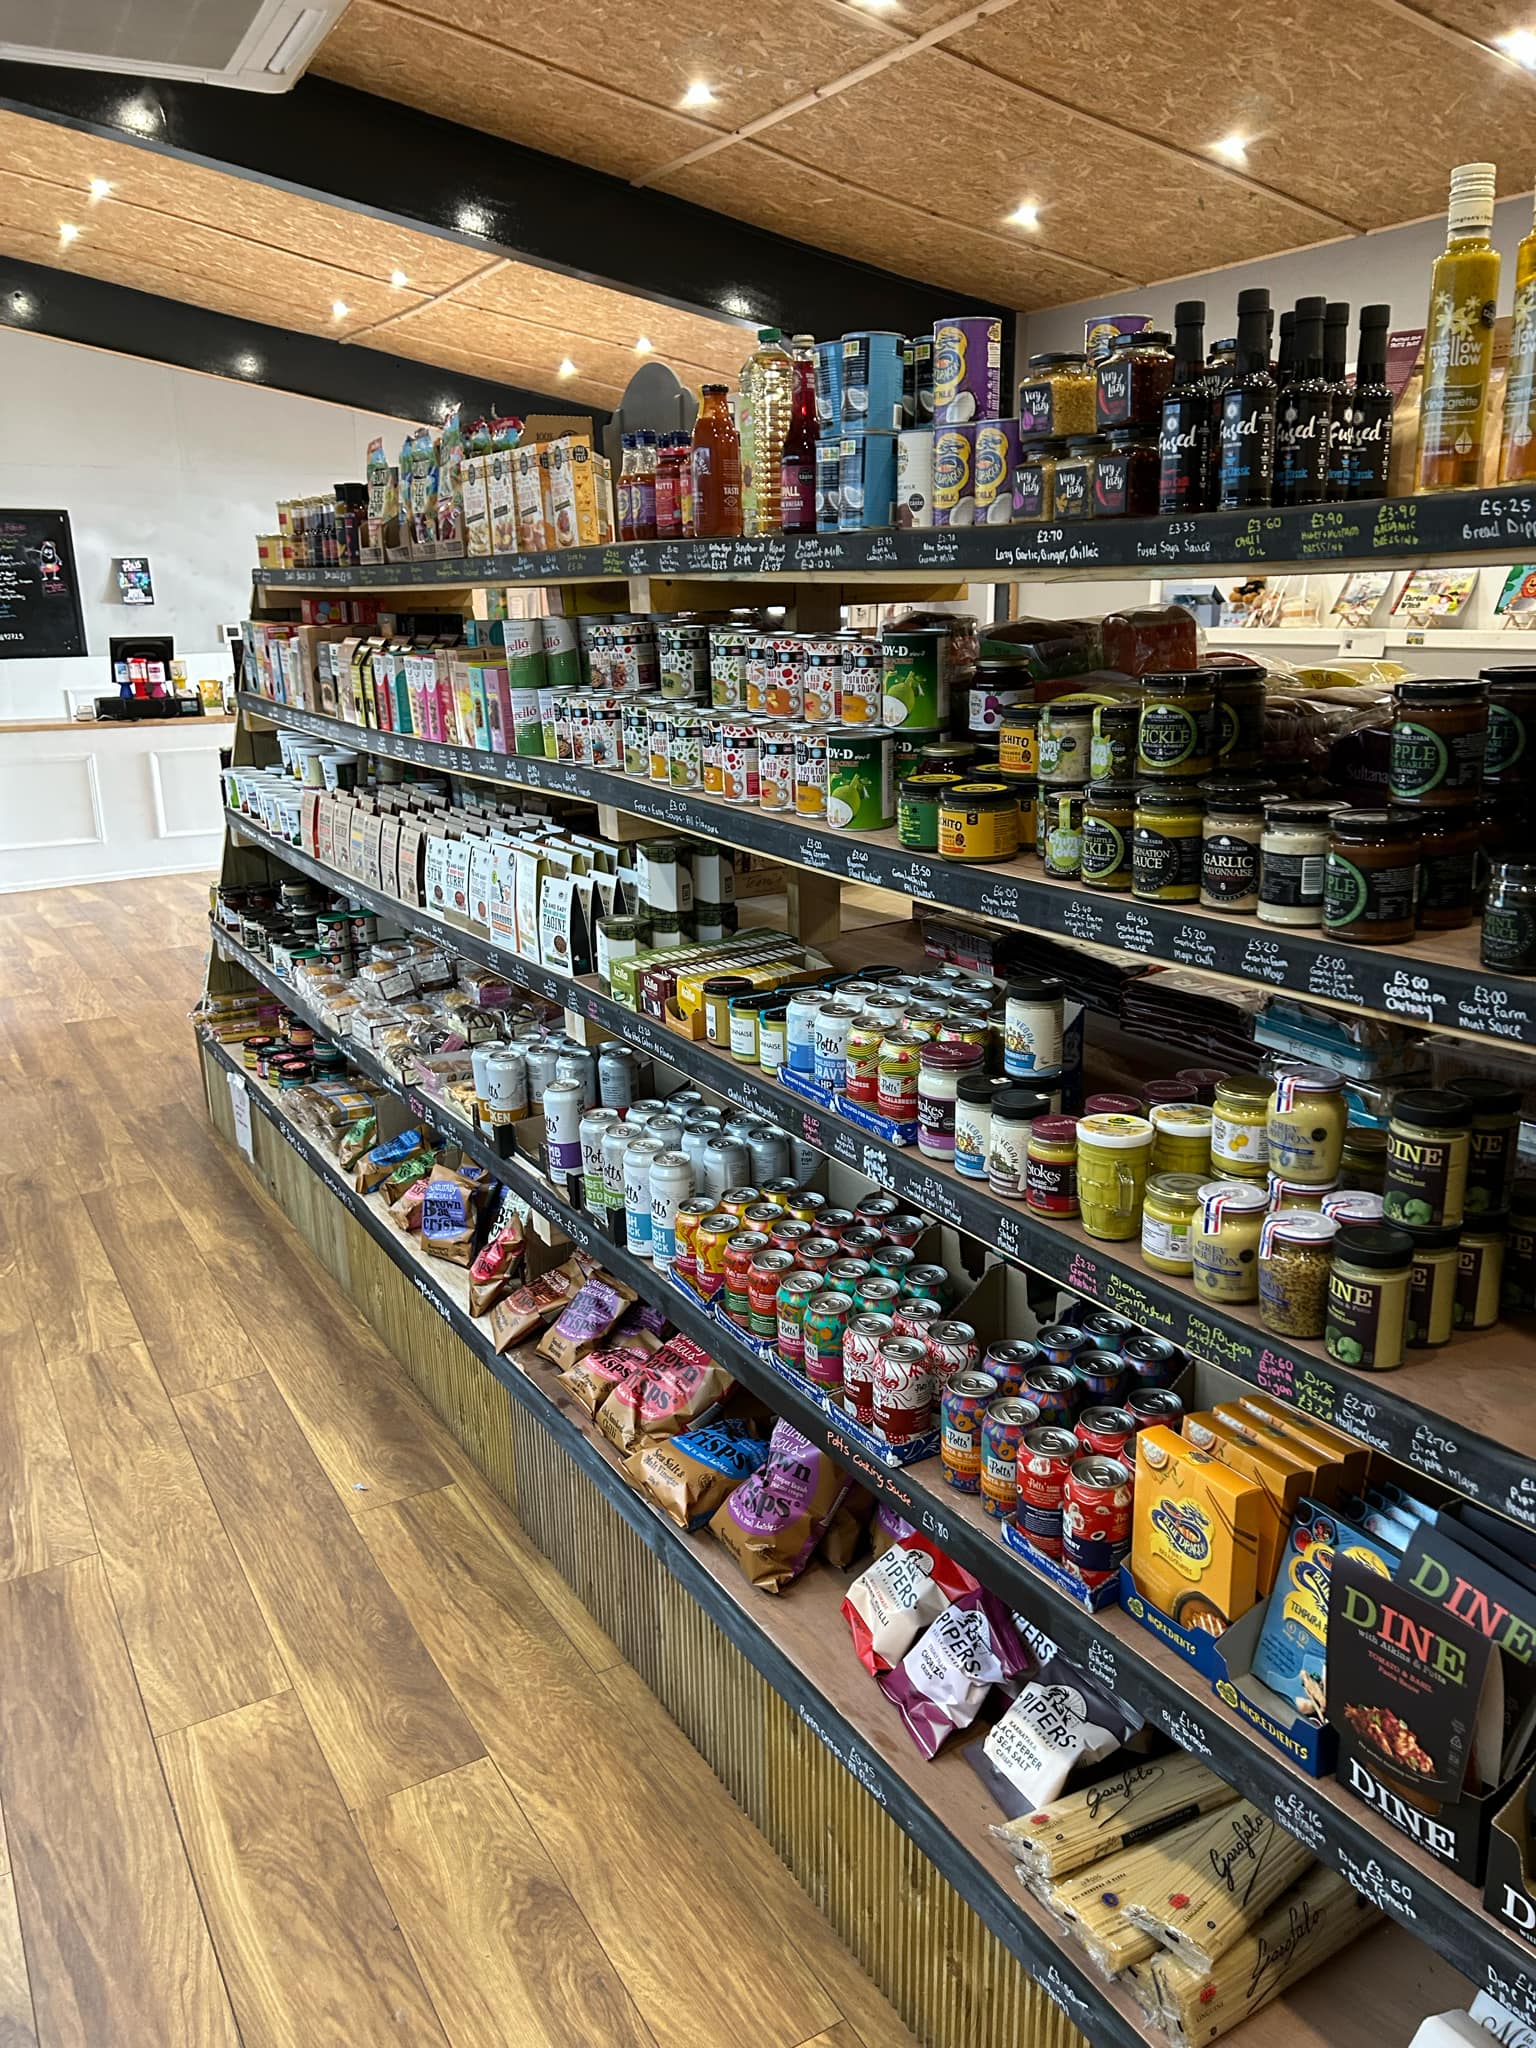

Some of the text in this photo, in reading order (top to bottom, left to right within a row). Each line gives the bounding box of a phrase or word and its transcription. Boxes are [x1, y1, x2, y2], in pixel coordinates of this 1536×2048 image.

[1429, 335, 1483, 355] mellow
[1432, 351, 1480, 372] yellow
[1100, 369, 1124, 386] Very
[1024, 389, 1048, 404] Very
[1108, 380, 1125, 398] Lazy
[1032, 400, 1049, 416] Lazy
[1016, 470, 1039, 485] Very
[1059, 471, 1082, 487] Very
[1098, 462, 1119, 478] Very
[1022, 481, 1040, 497] Lazy
[1066, 482, 1084, 498] Lazy
[1105, 474, 1124, 490] Lazy
[1377, 505, 1416, 523] £3.90
[1480, 499, 1531, 515] £5.25
[1169, 522, 1196, 535] £3.35
[1248, 518, 1281, 533] £3.60
[1312, 512, 1343, 528] £3.90
[1037, 529, 1063, 543] £2.70
[1462, 522, 1500, 540] Bread
[824, 544, 844, 557] Milk
[995, 548, 1013, 565] Lazy
[1138, 541, 1210, 559] Fused Soya Sauce
[861, 684, 875, 693] SOUP
[1142, 729, 1191, 744] PICKLE
[634, 800, 647, 812] Free
[807, 838, 822, 850] £3.00
[1084, 841, 1116, 857] CKLE
[852, 849, 869, 861] £2.60
[1203, 852, 1254, 869] GARLIC
[911, 862, 931, 877] £3.50
[1203, 866, 1254, 878] MAYONNAISE
[993, 884, 1018, 899] £6.00
[1000, 897, 1017, 908] Love
[543, 914, 566, 933] TAGINE
[1182, 925, 1207, 940] £5.20
[1197, 941, 1216, 954] Farm
[1248, 939, 1279, 953] £5.20
[1270, 956, 1289, 968] Farm
[1263, 965, 1284, 984] Mayo
[1394, 970, 1429, 990] £5.60
[1474, 985, 1507, 1004] £3.00
[1458, 1001, 1532, 1023] Garlic Farm
[1015, 1018, 1035, 1045] VEGAN
[1488, 1018, 1523, 1039] Sauce
[816, 1032, 842, 1055] Potts'
[820, 1080, 832, 1089] HP
[965, 1121, 984, 1146] VEGAN
[999, 1139, 1019, 1167] VEGAN
[1027, 1159, 1062, 1186] Stokes
[532, 1191, 548, 1208] Potts
[545, 1201, 564, 1224] Stock
[1110, 1273, 1147, 1300] Biona
[1330, 1277, 1373, 1308] INE
[1115, 1301, 1148, 1327] £4.10
[781, 1320, 799, 1335] Potts'
[1210, 1326, 1252, 1359] Poupon
[1261, 1349, 1295, 1371] £2.60
[1257, 1361, 1293, 1383] Biona
[1256, 1373, 1294, 1397] Dijon
[1297, 1394, 1333, 1421] £3.20
[1343, 1392, 1376, 1418] £2.70
[1342, 1409, 1368, 1427] Dine
[947, 1430, 971, 1449] Potts'
[1411, 1439, 1439, 1460] Dine
[652, 1448, 680, 1474] Sea Salt
[826, 1431, 885, 1490] Potts Cooking
[988, 1461, 1014, 1478] Potts'
[922, 1511, 949, 1540] £3.80
[1163, 1516, 1177, 1539] BLUE
[1290, 1600, 1322, 1630] TEMPURA
[1409, 1553, 1536, 1664] DINE
[1147, 1611, 1197, 1657] INGREDIENTS
[1341, 1585, 1467, 1685] DINE
[1358, 1628, 1411, 1664] with Atkins
[921, 1649, 945, 1680] CHORIZO
[1180, 1711, 1206, 1739] £1.95
[1240, 1699, 1309, 1760] INGREDIENTS
[1182, 1724, 1213, 1756] Dragon
[997, 1734, 1031, 1771] SEA SALT
[1015, 1742, 1043, 1771] PEPPER
[1288, 1793, 1324, 1829] £2.16
[1349, 1755, 1457, 1862] DINE
[1365, 1860, 1412, 1900] £3.60
[1370, 1876, 1418, 1920] Tomato
